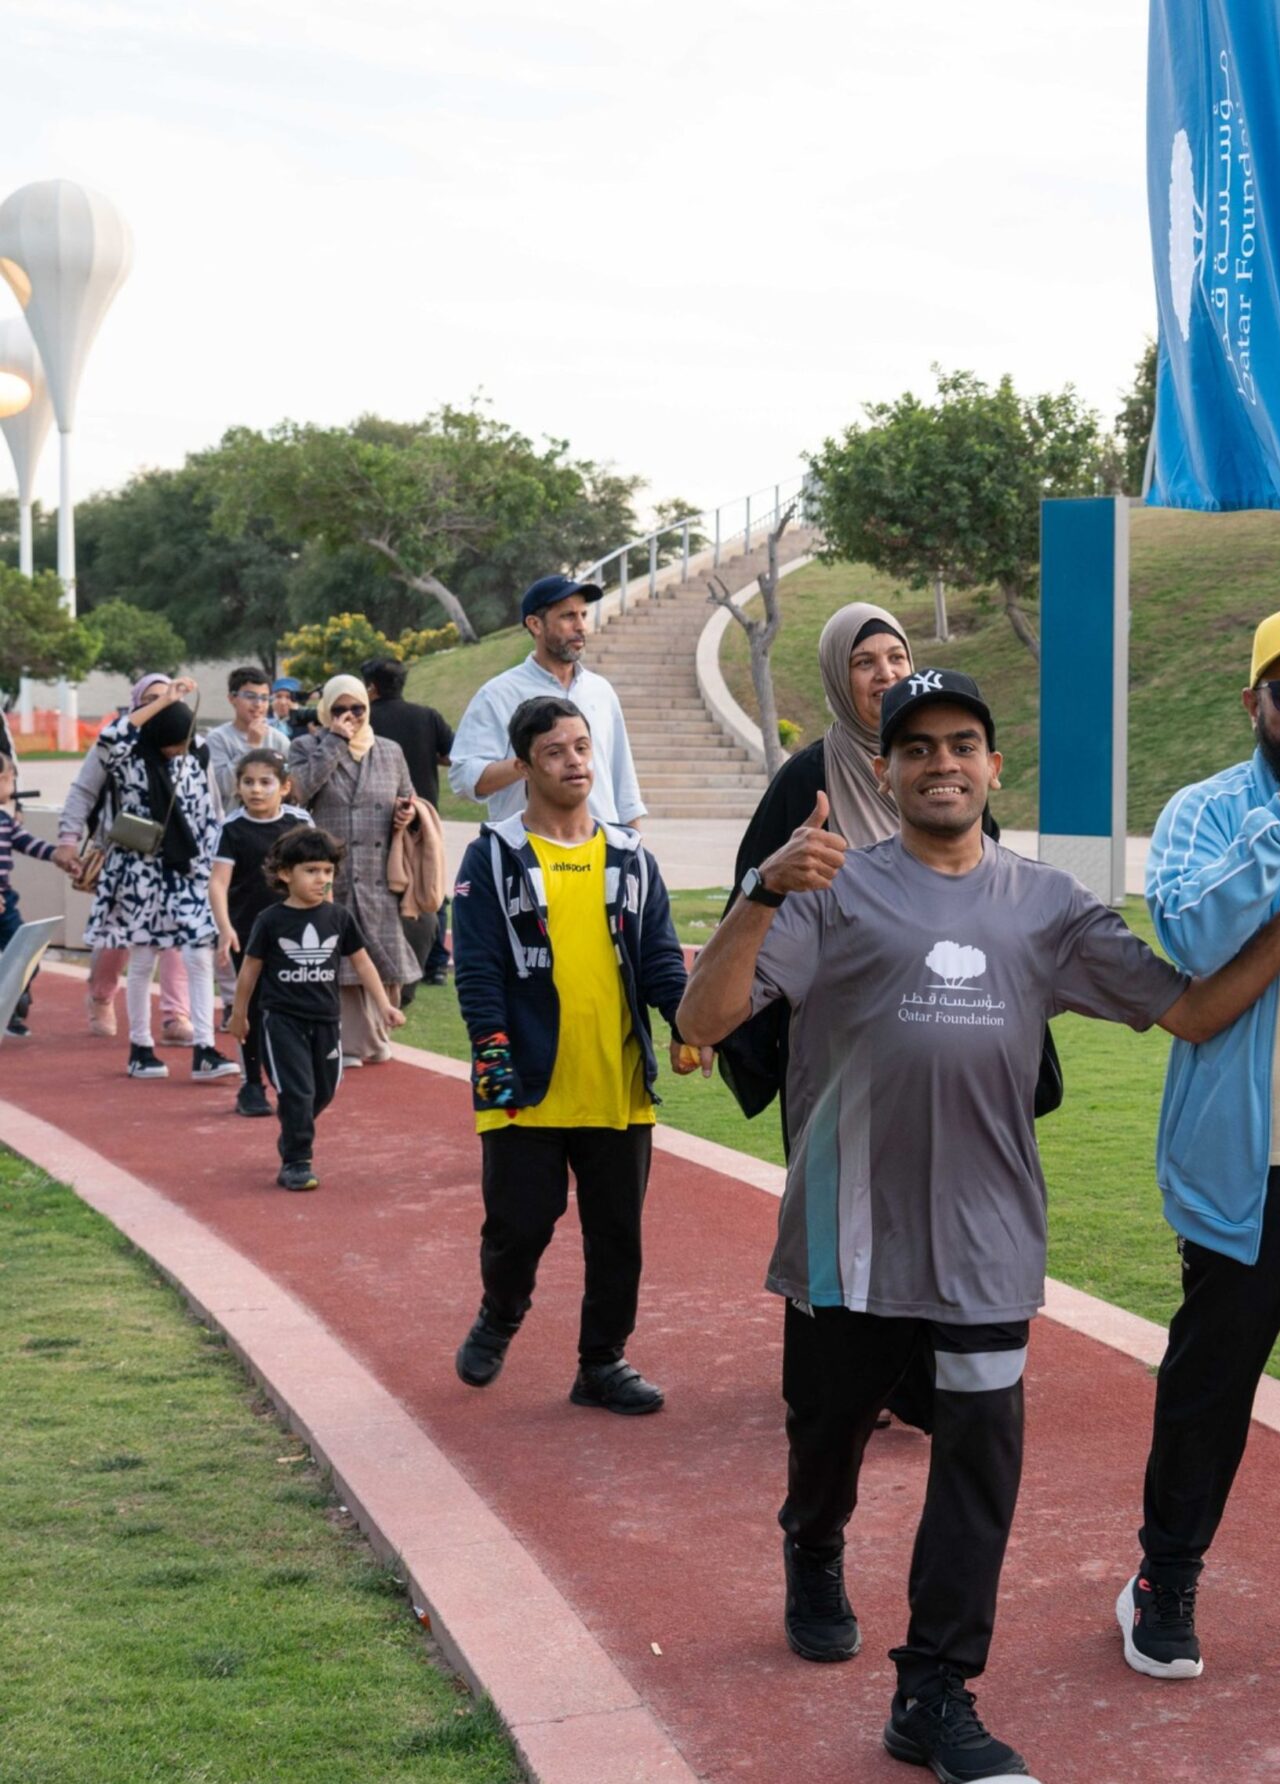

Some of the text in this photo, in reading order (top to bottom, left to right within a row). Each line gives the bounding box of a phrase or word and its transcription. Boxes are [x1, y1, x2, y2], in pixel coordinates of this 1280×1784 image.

[1213, 50, 1234, 275] مؤسسة
[1235, 101, 1256, 284] Found
[908, 669, 943, 696] NY
[549, 861, 592, 873] uhlsport
[278, 966, 336, 982] adidas
[900, 992, 1006, 1011] مؤسسة قطر
[898, 1008, 1005, 1026] Qatar Foundation
